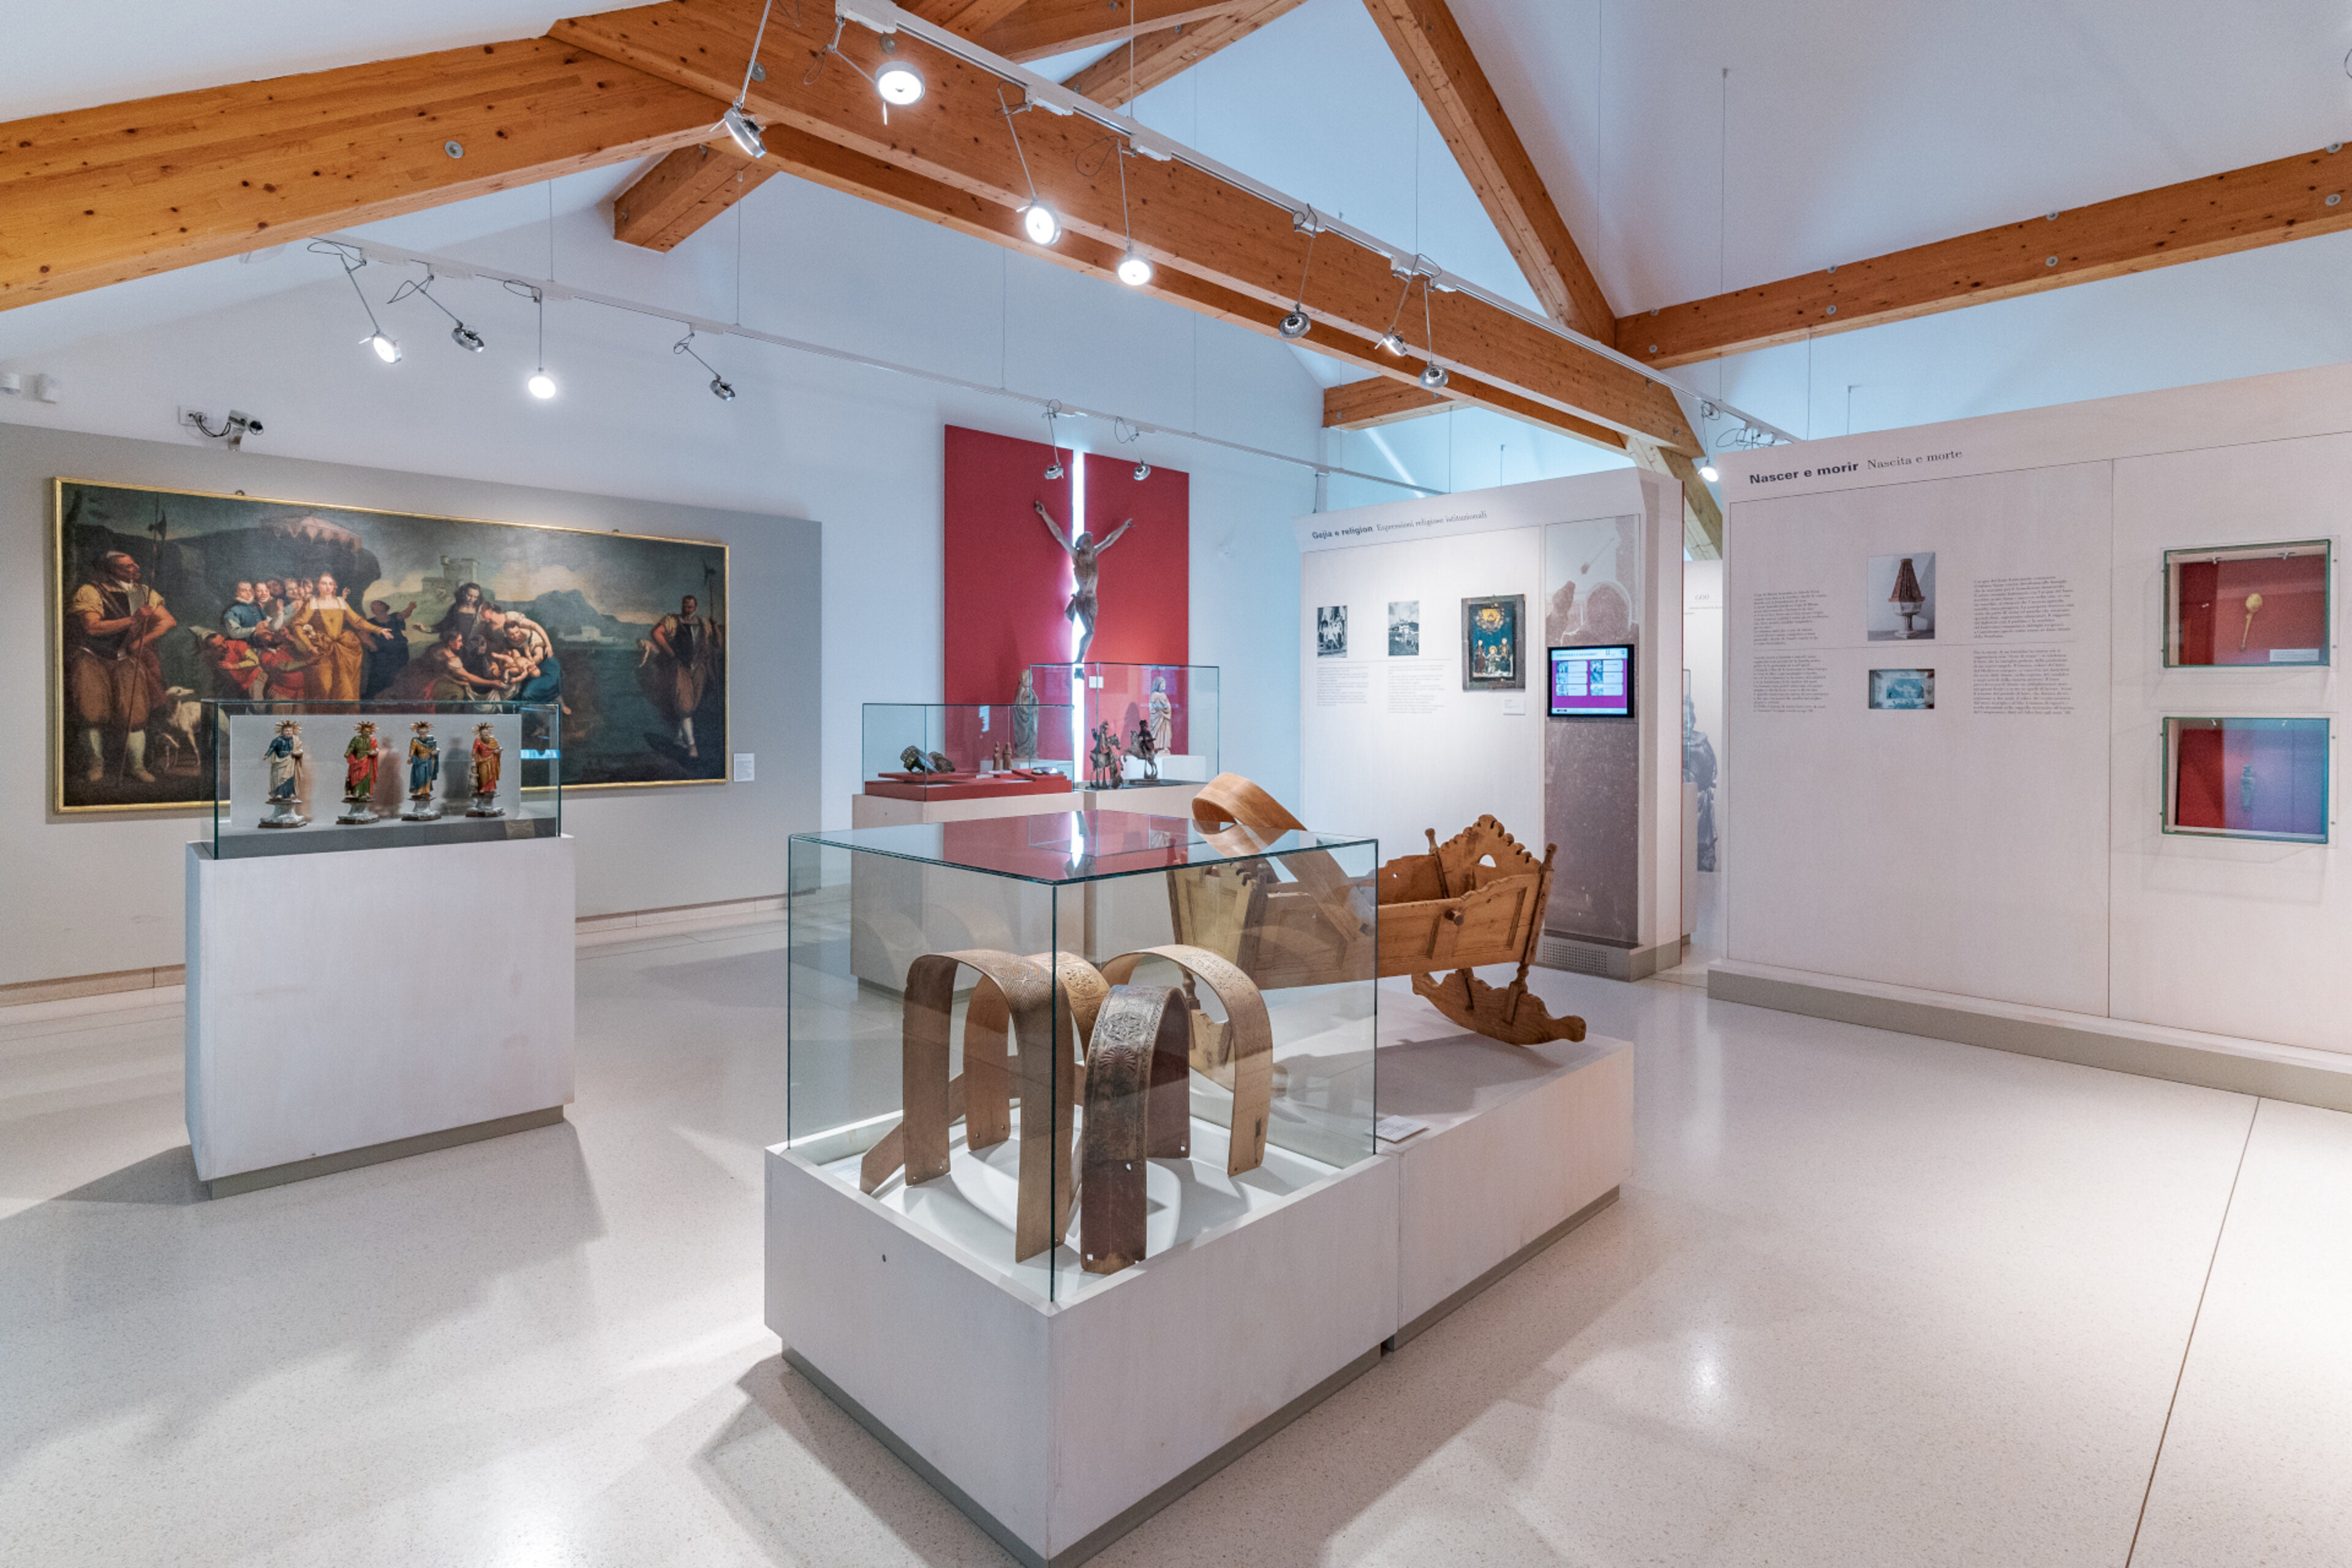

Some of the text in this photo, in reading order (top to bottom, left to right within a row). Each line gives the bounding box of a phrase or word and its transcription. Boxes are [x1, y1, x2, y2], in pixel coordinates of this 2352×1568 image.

[1749, 471, 1799, 484] Nascer
[1817, 461, 1859, 476] morir
[1867, 456, 1912, 469] Nascita
[1926, 450, 1962, 461] morte
[1341, 525, 1373, 536] religion
